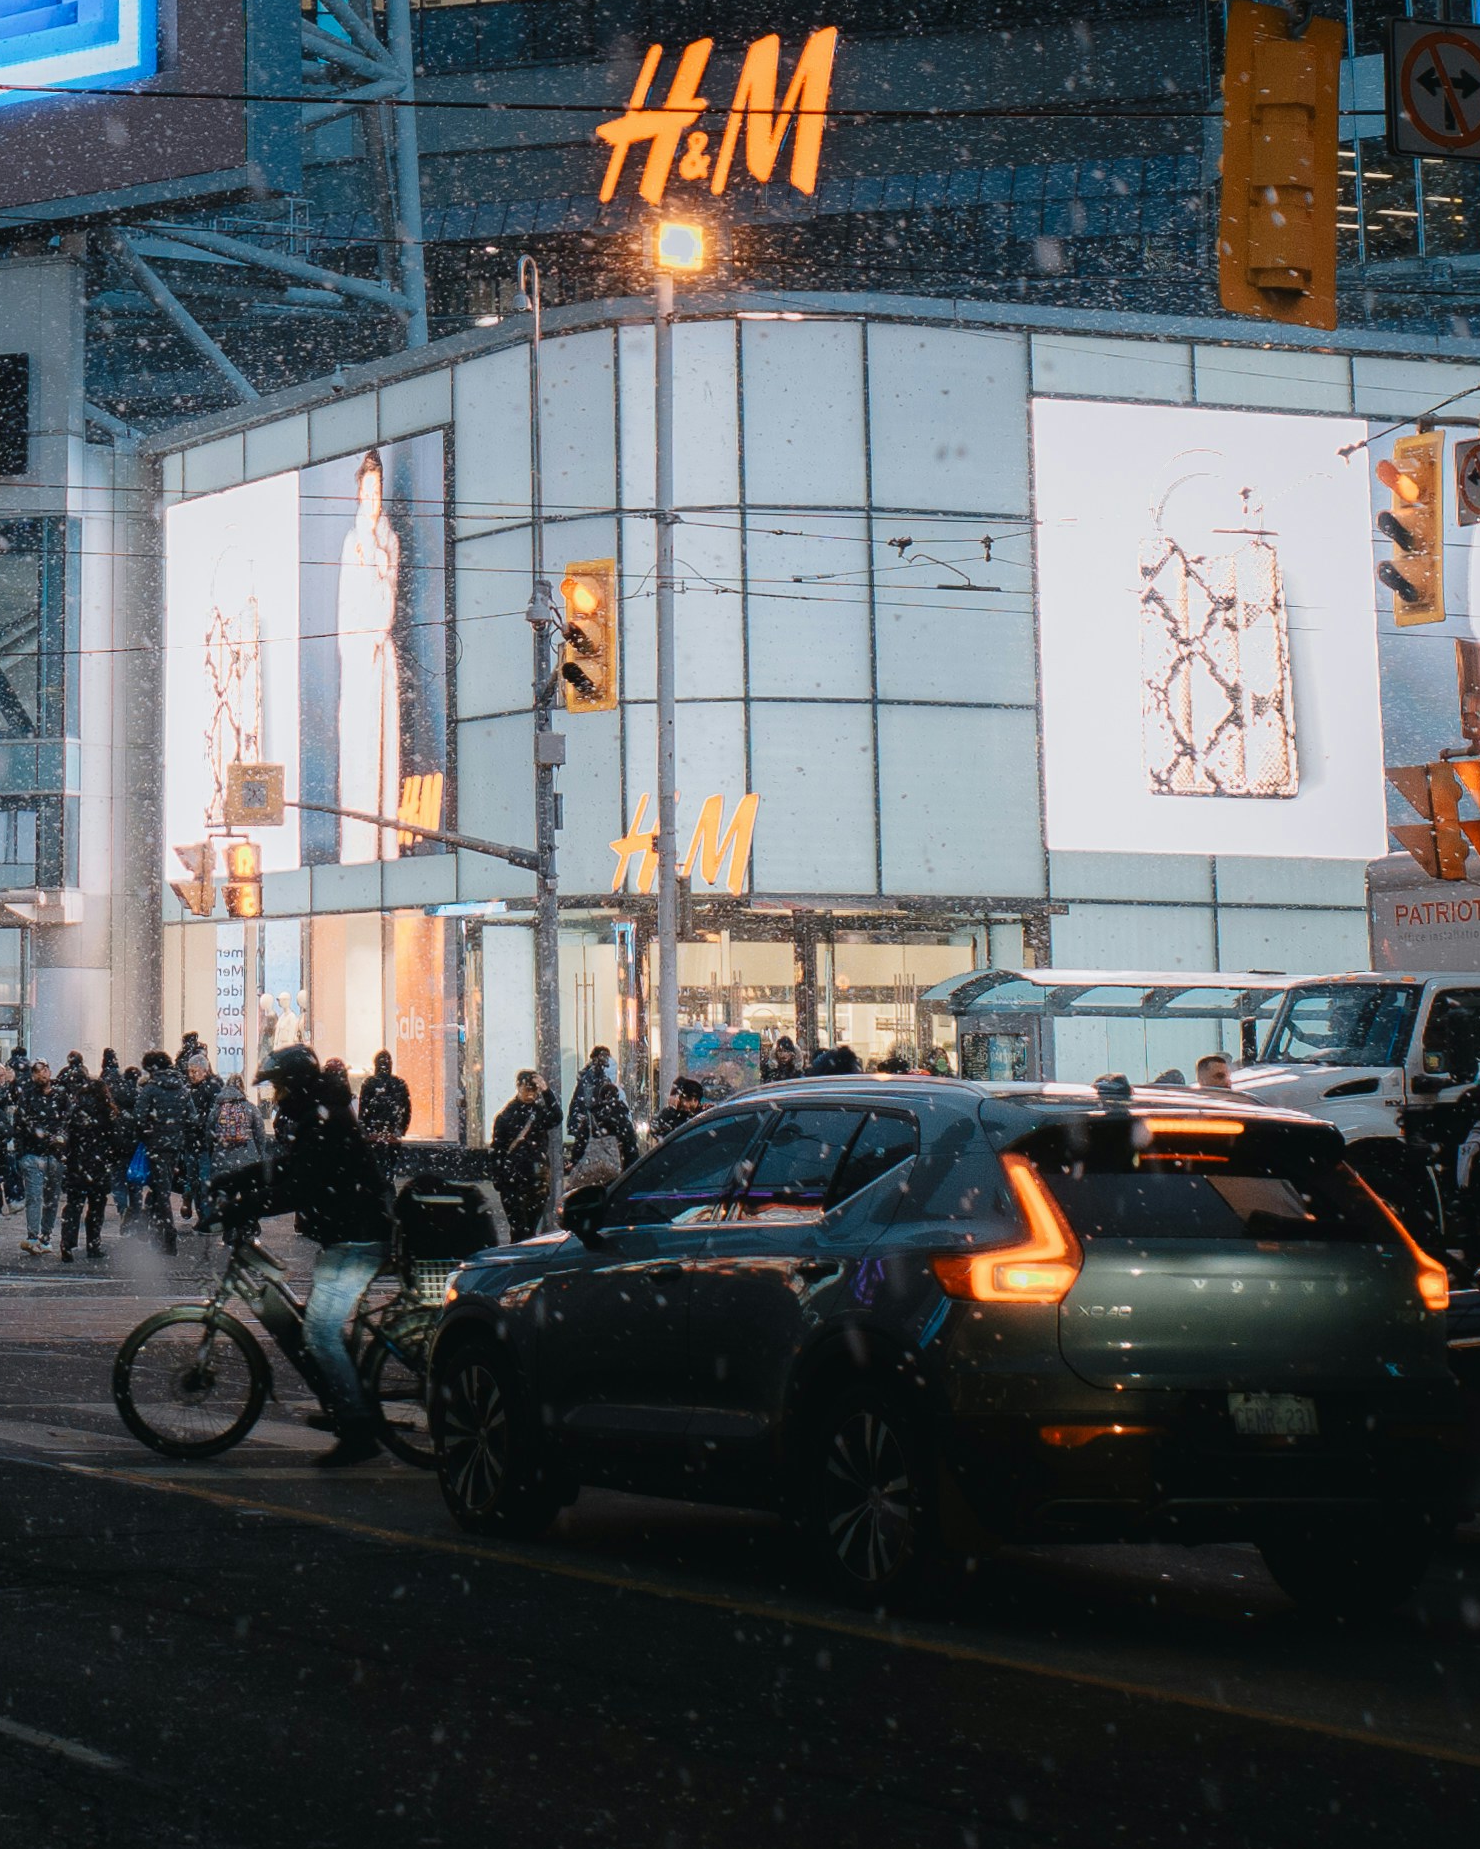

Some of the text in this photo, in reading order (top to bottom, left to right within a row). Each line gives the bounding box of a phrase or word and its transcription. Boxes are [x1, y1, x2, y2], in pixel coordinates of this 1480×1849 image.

[595, 26, 838, 207] H&M
[609, 792, 760, 896] HM
[399, 1005, 426, 1041] ale
[1078, 1305, 1133, 1319] XC40
